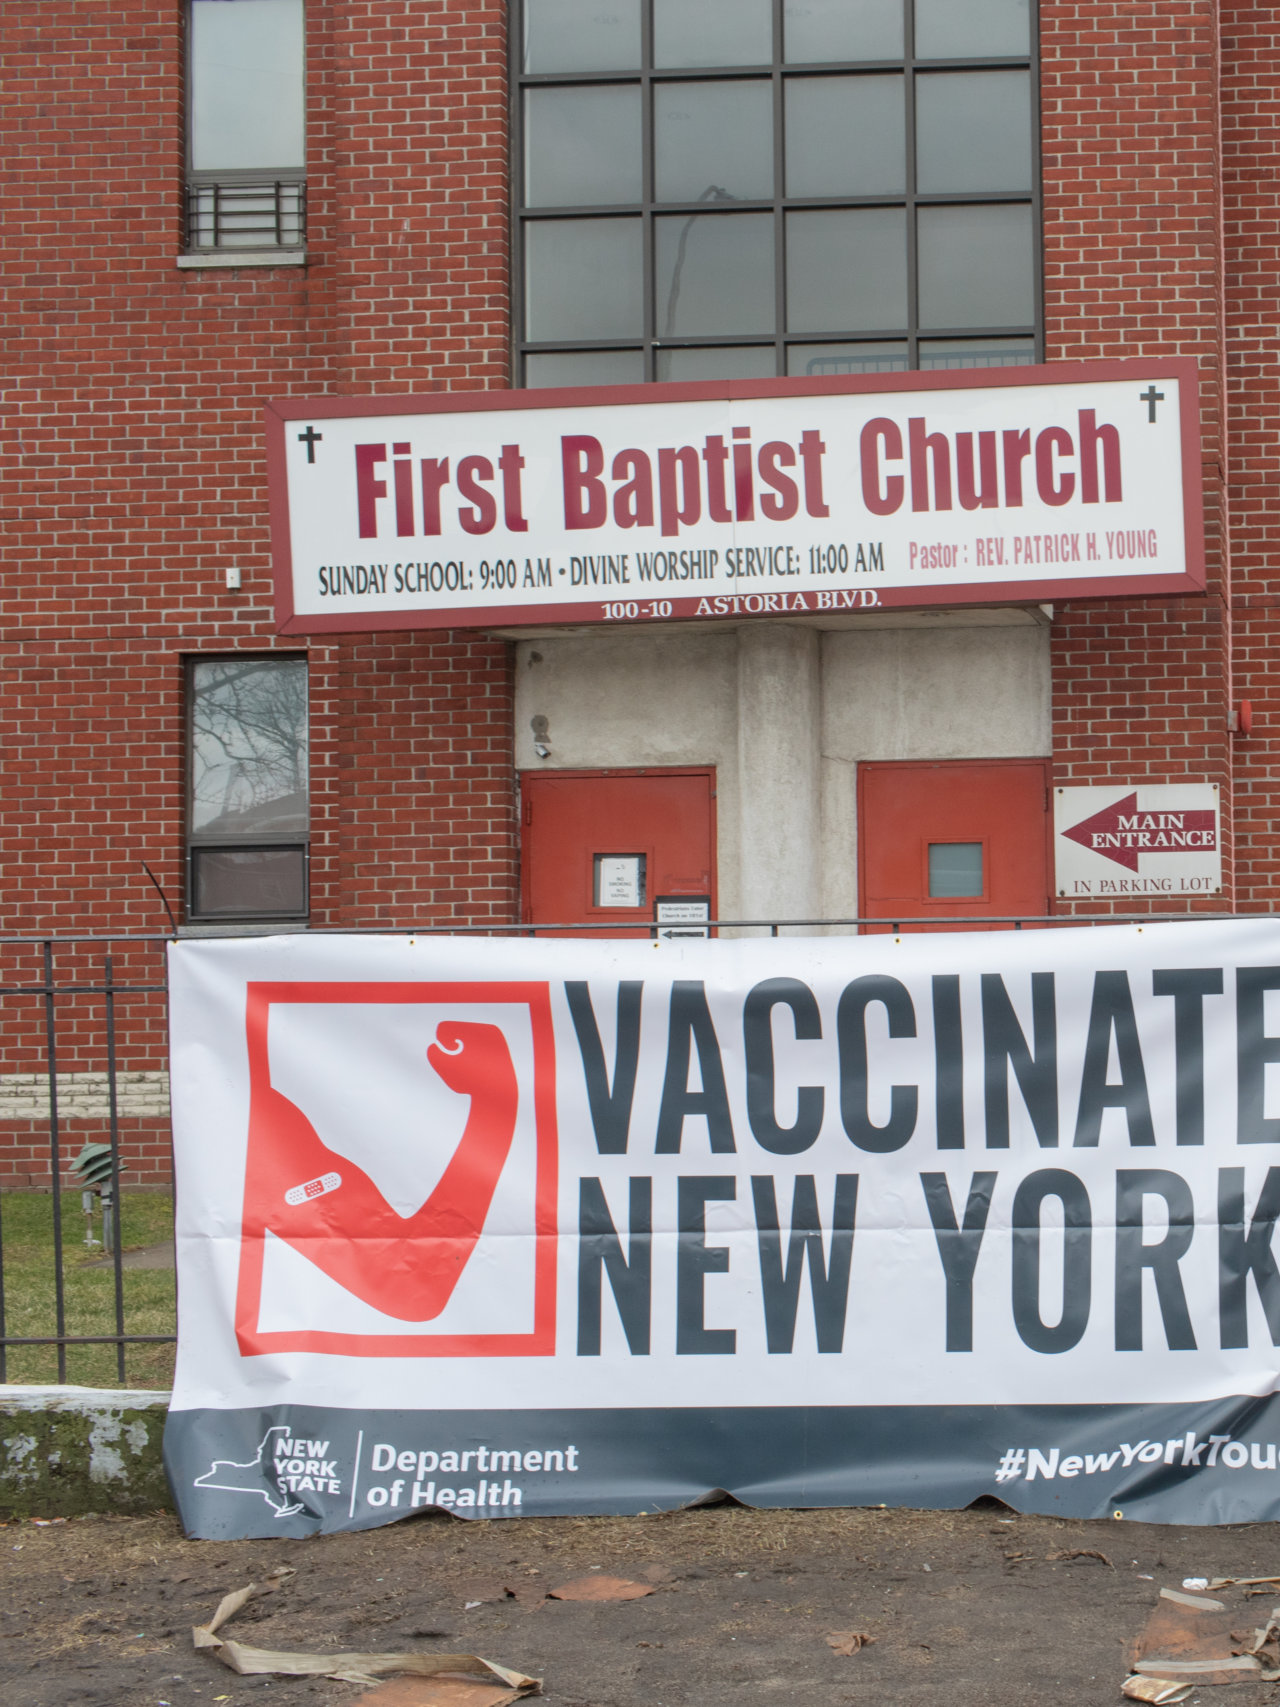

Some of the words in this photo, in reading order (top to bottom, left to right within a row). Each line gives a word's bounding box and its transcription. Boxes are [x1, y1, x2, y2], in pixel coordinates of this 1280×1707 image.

[355, 441, 529, 539] First
[560, 426, 830, 537] Baptist
[859, 408, 1123, 516] Church
[975, 535, 1009, 566] REV.
[1013, 532, 1081, 565] PATRICK
[1086, 531, 1102, 561] H.
[1106, 528, 1158, 558] YOUNG
[318, 564, 389, 596] SUNDAY
[394, 560, 474, 593] SCHOOL:
[480, 558, 517, 590] 9:00
[522, 556, 553, 588] AM
[570, 554, 631, 587] DIVINE
[635, 549, 719, 582] WORSHIP
[725, 544, 801, 578] SERVICE:
[808, 542, 850, 575] 11:00
[854, 541, 886, 573] AM
[601, 599, 673, 620] 100-10
[694, 592, 809, 616] ASTORIA
[814, 588, 883, 611] BLVD.
[1117, 813, 1185, 830] MAIN
[1091, 830, 1214, 848] ENTRANCE
[1074, 880, 1091, 893] IN
[1100, 878, 1172, 892] PARKING
[1180, 876, 1212, 890] LOT
[576, 1172, 860, 1356] NEW
[276, 1438, 330, 1458] NEW
[371, 1443, 580, 1480] Department
[274, 1458, 338, 1478] YORK
[278, 1476, 341, 1495] STATE
[366, 1480, 402, 1507] of
[411, 1480, 522, 1507] Health
